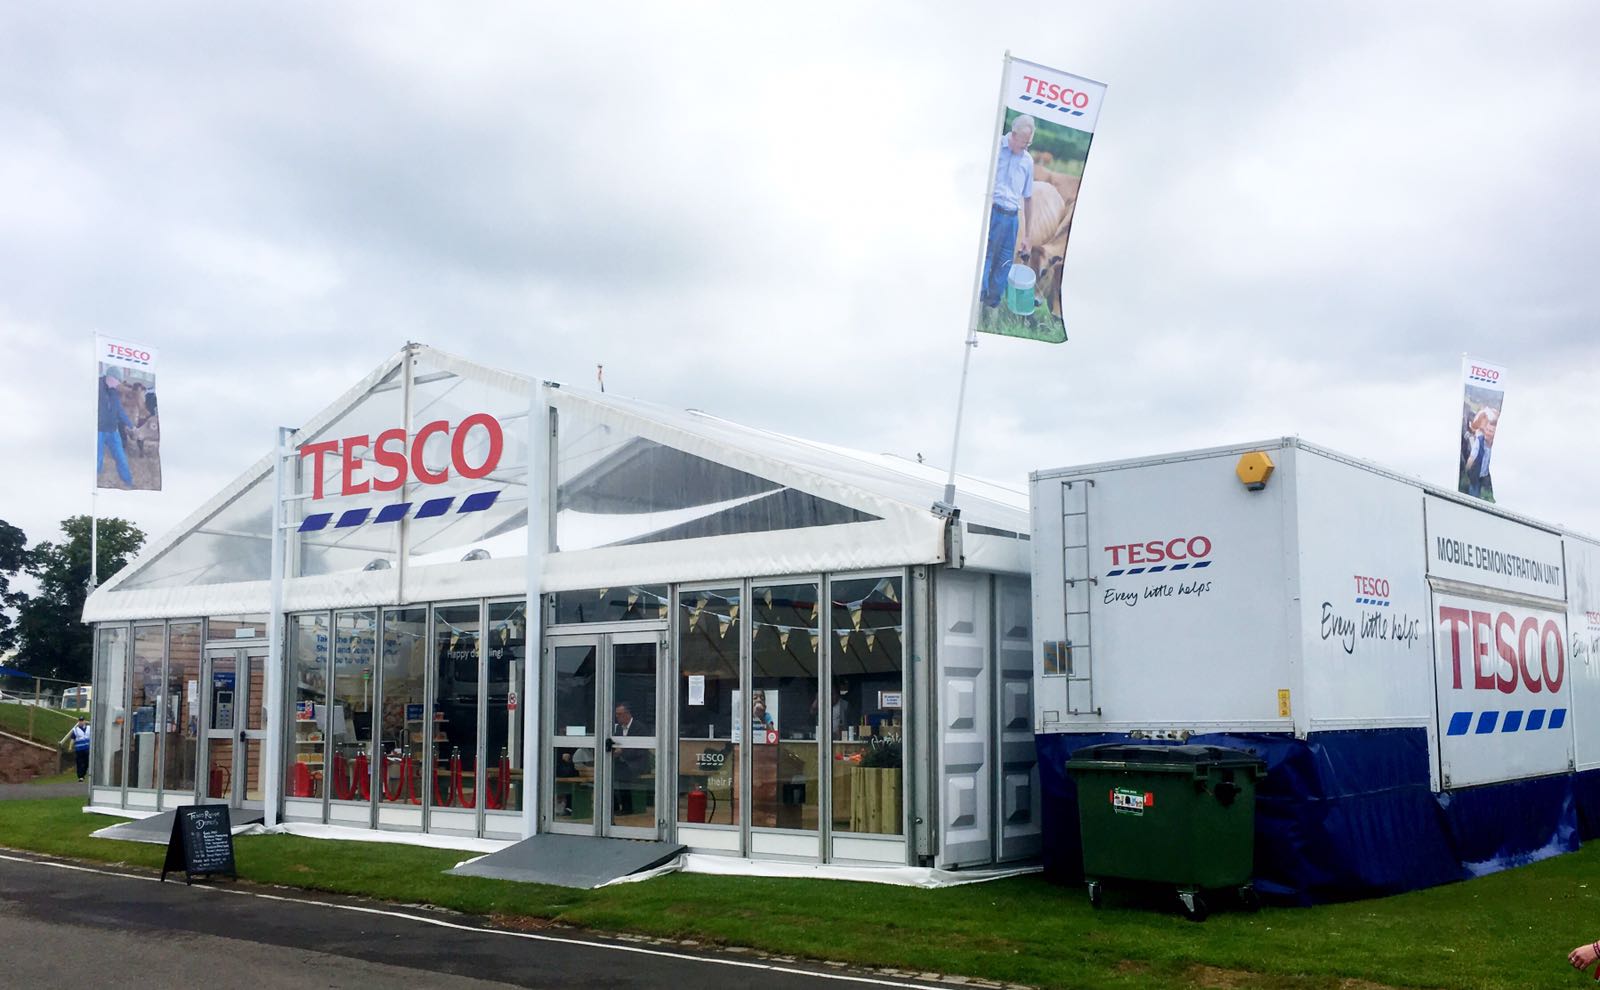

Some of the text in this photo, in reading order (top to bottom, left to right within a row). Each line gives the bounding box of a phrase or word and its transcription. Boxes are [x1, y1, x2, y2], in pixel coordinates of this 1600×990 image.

[1024, 76, 1089, 108] TESCO
[107, 343, 150, 361] TESCO
[1471, 365, 1499, 380] TESCO
[300, 413, 503, 500] TESCO
[1104, 536, 1212, 565] TESCO
[1437, 536, 1560, 586] MOBILE DEMONSTRATION UNIT
[1103, 581, 1212, 606] Every little helps
[1354, 575, 1389, 598] TESCO
[1321, 602, 1419, 654] Every little helps
[1586, 611, 1600, 625] TESC
[447, 650, 469, 660] Happy
[1439, 605, 1565, 694] TESCO
[696, 753, 724, 762] TESCO
